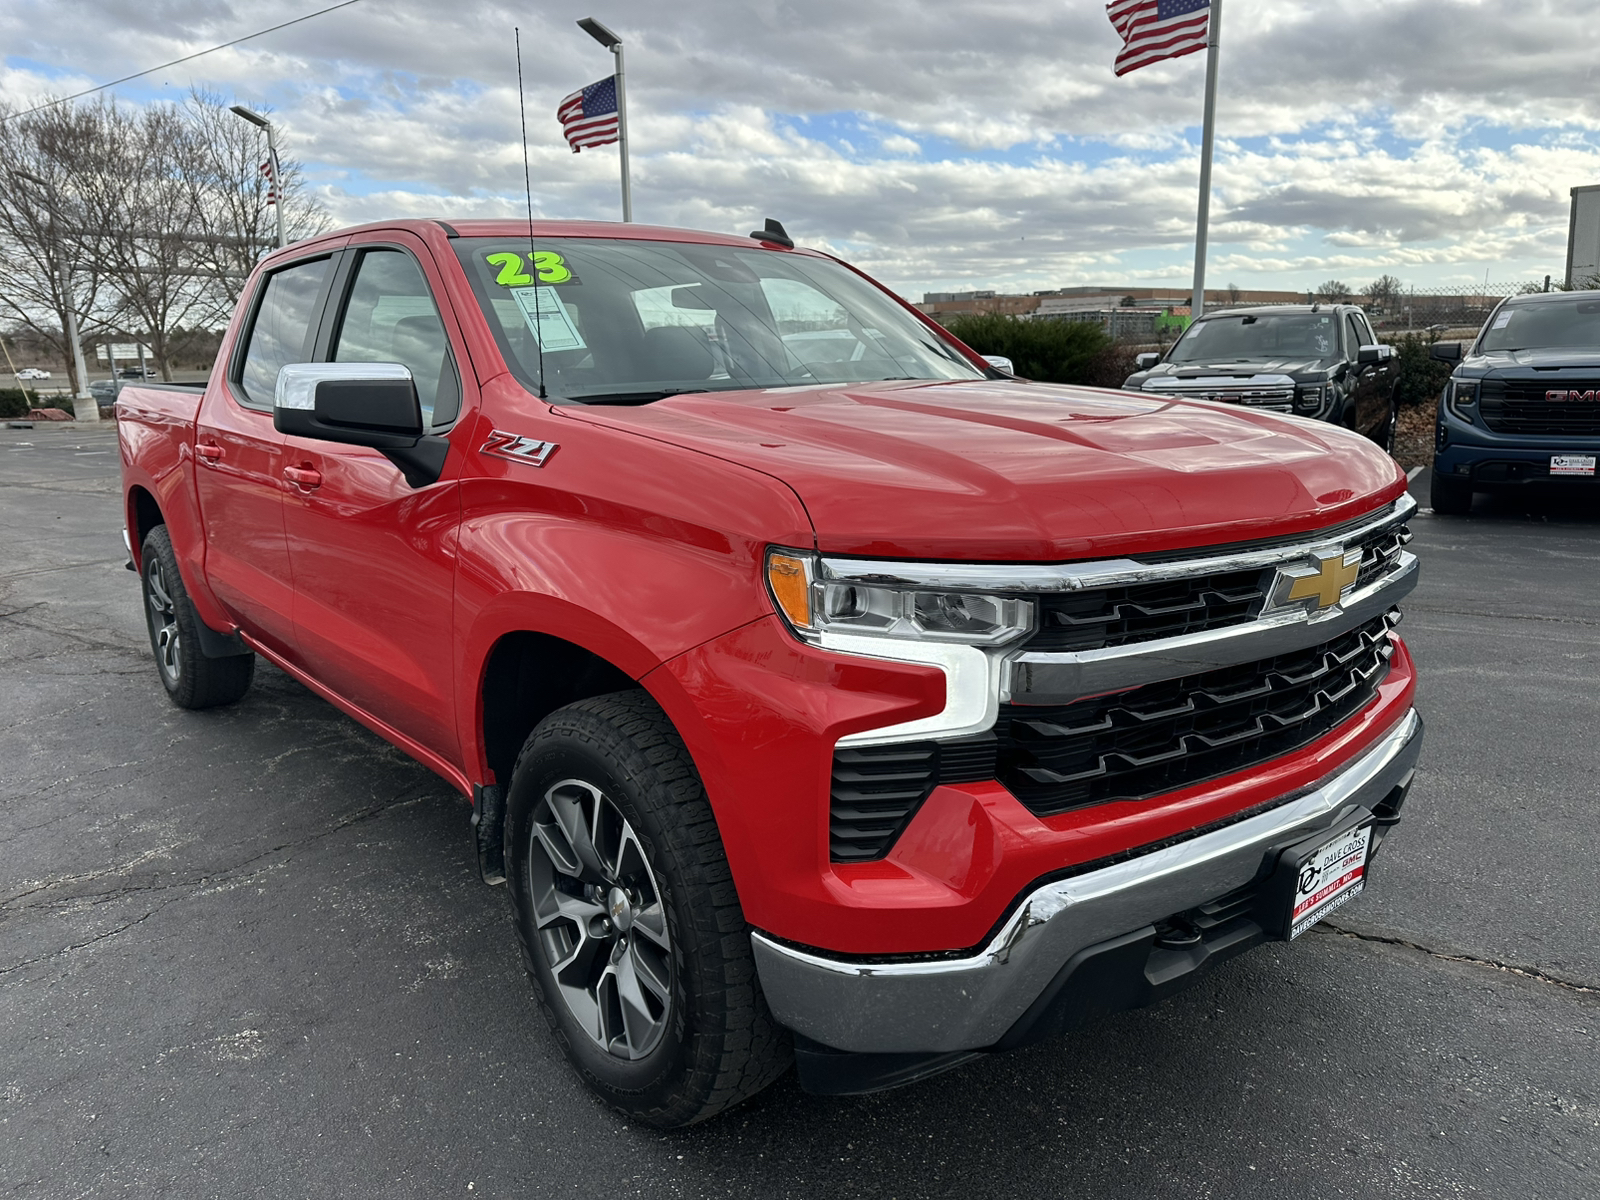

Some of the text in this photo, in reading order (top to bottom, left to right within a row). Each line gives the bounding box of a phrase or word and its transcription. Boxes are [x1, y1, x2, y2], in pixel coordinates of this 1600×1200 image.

[486, 249, 572, 286] 23
[1545, 390, 1600, 402] GM
[478, 429, 561, 467] Z71
[1323, 851, 1342, 866] DAVE
[1343, 836, 1366, 855] CROSS
[1342, 851, 1363, 867] GMC
[1343, 873, 1353, 883] MO
[1292, 882, 1364, 937] DAVECROSSMOTORS.COM
